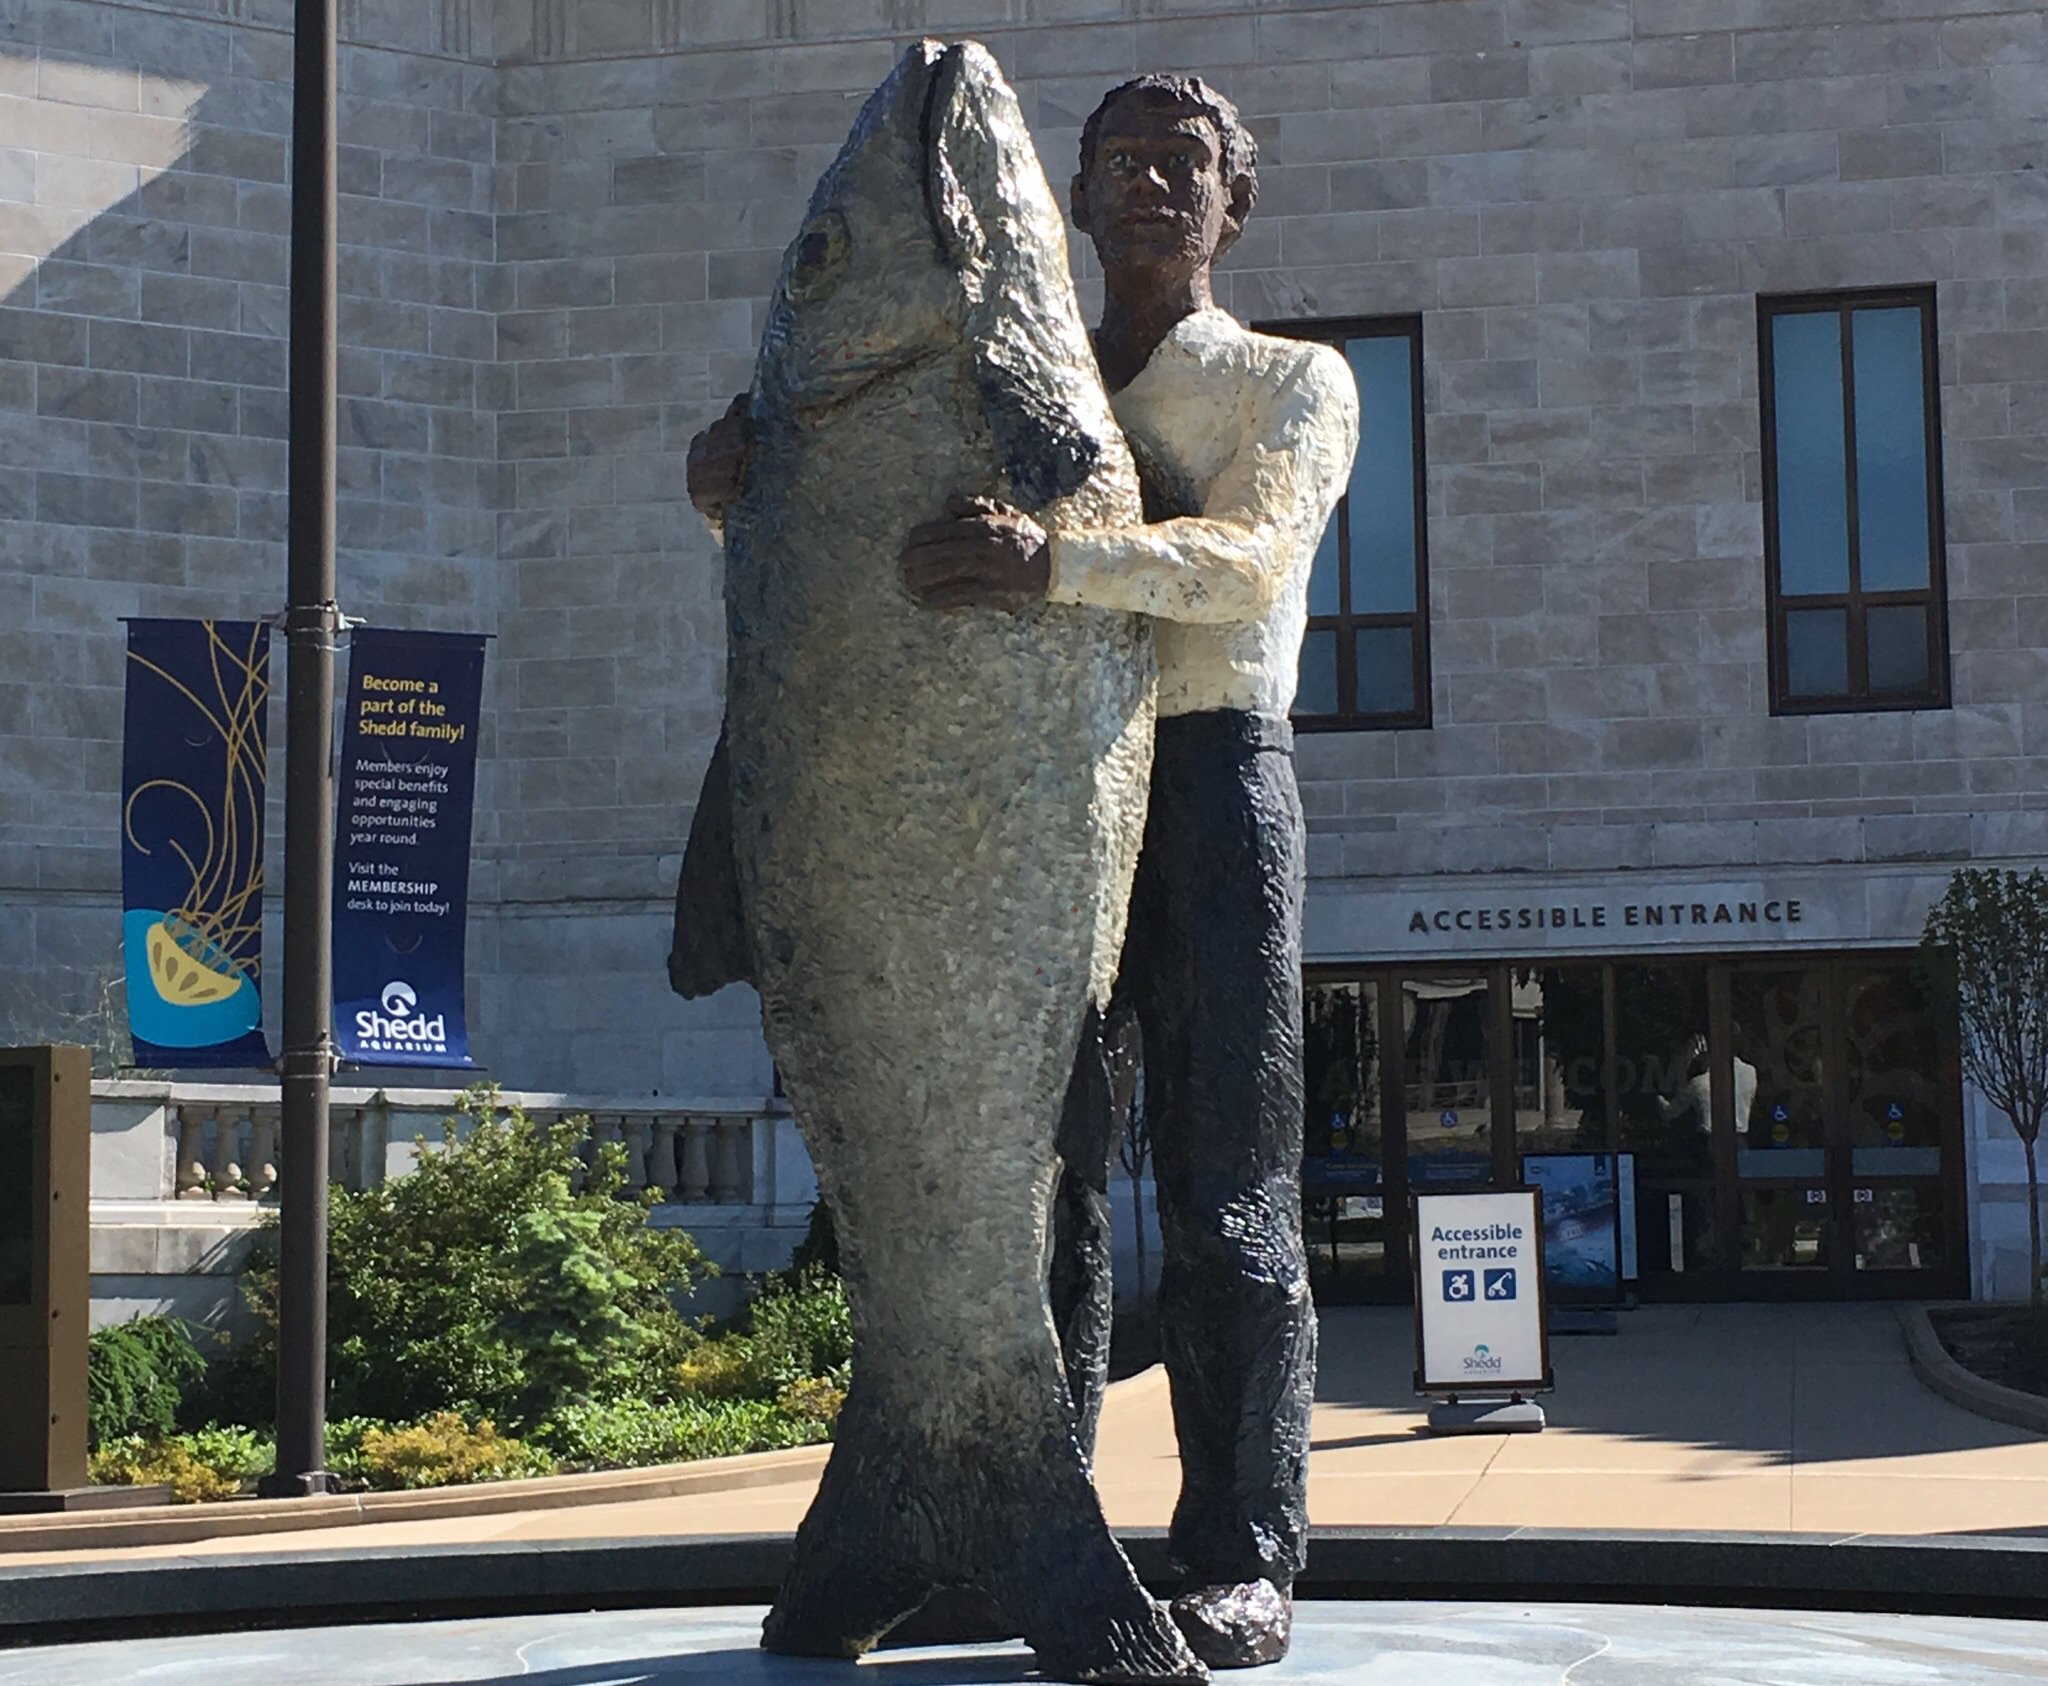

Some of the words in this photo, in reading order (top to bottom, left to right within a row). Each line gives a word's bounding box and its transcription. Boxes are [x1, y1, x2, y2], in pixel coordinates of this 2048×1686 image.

[362, 674, 425, 693] Become
[428, 680, 439, 694] a
[360, 699, 394, 716] part
[398, 699, 416, 714] of
[419, 701, 446, 717] the
[359, 719, 406, 736] Shedd
[410, 722, 465, 743] family!
[355, 759, 412, 774] Members
[415, 763, 448, 779] enjoy
[354, 778, 396, 792] special
[398, 779, 449, 794] benefits
[353, 795, 376, 808] and
[379, 798, 438, 814] engaging
[351, 814, 436, 829] opportunities
[350, 832, 377, 845] year
[349, 862, 375, 874] Visit
[378, 863, 399, 876] the
[348, 880, 438, 895] MEMBERSHIP
[347, 899, 374, 911] desk
[376, 901, 388, 911] to
[389, 901, 411, 914] join
[414, 902, 450, 916] today!
[1408, 905, 1606, 934] ACCESSIBLE
[1625, 900, 1802, 926] ENTRANCE
[355, 1011, 446, 1041] Shedd
[360, 1039, 447, 1052] AQUARIUM
[1431, 1223, 1523, 1241] Accessible
[1438, 1245, 1518, 1259] entrance
[1463, 1356, 1502, 1369] Shedd
